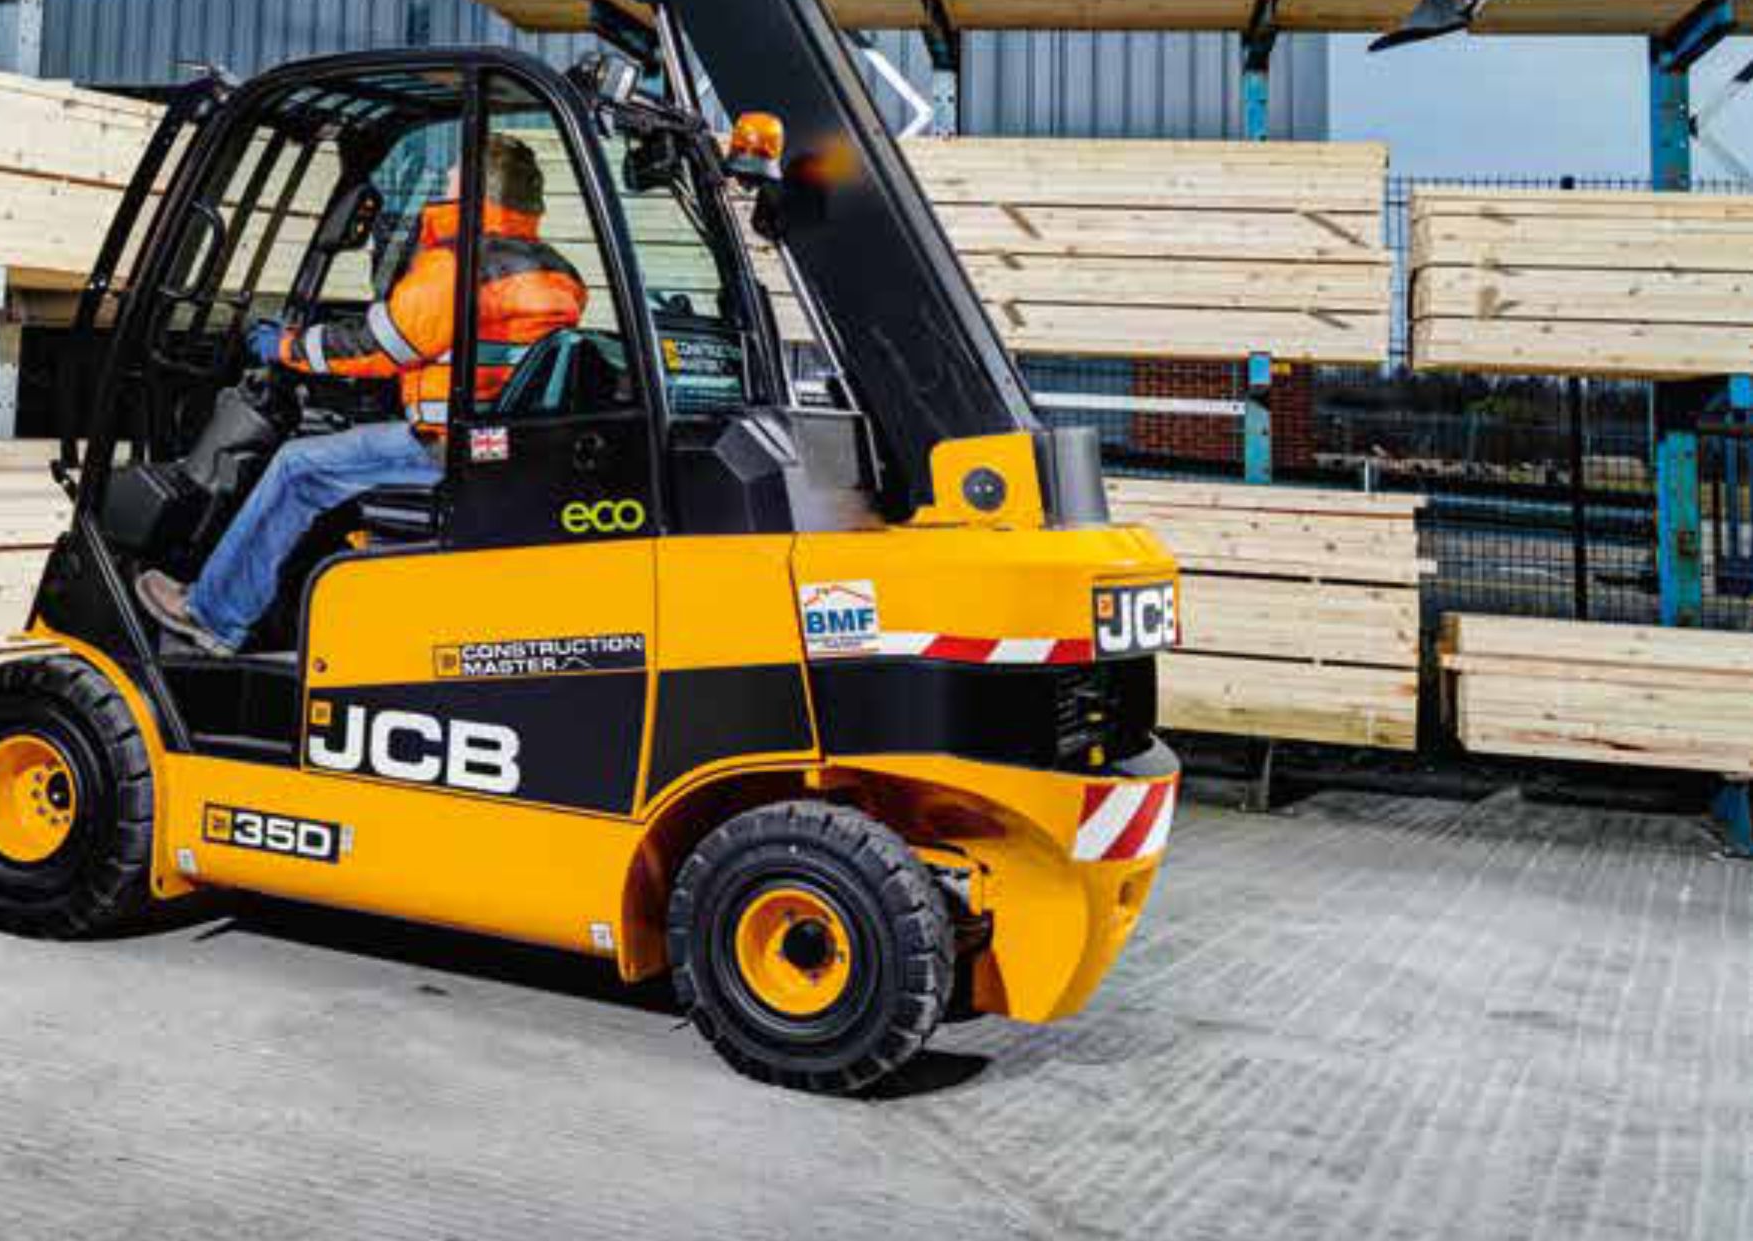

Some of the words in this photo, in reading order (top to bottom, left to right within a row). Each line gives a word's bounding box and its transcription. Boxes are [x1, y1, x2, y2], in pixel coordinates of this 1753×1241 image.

[561, 499, 644, 533] eco
[806, 608, 875, 634] BMF
[461, 635, 644, 660] CONSTRUCTION
[462, 656, 557, 677] MASTER
[308, 705, 520, 795] JCB
[233, 811, 333, 857] 35D
